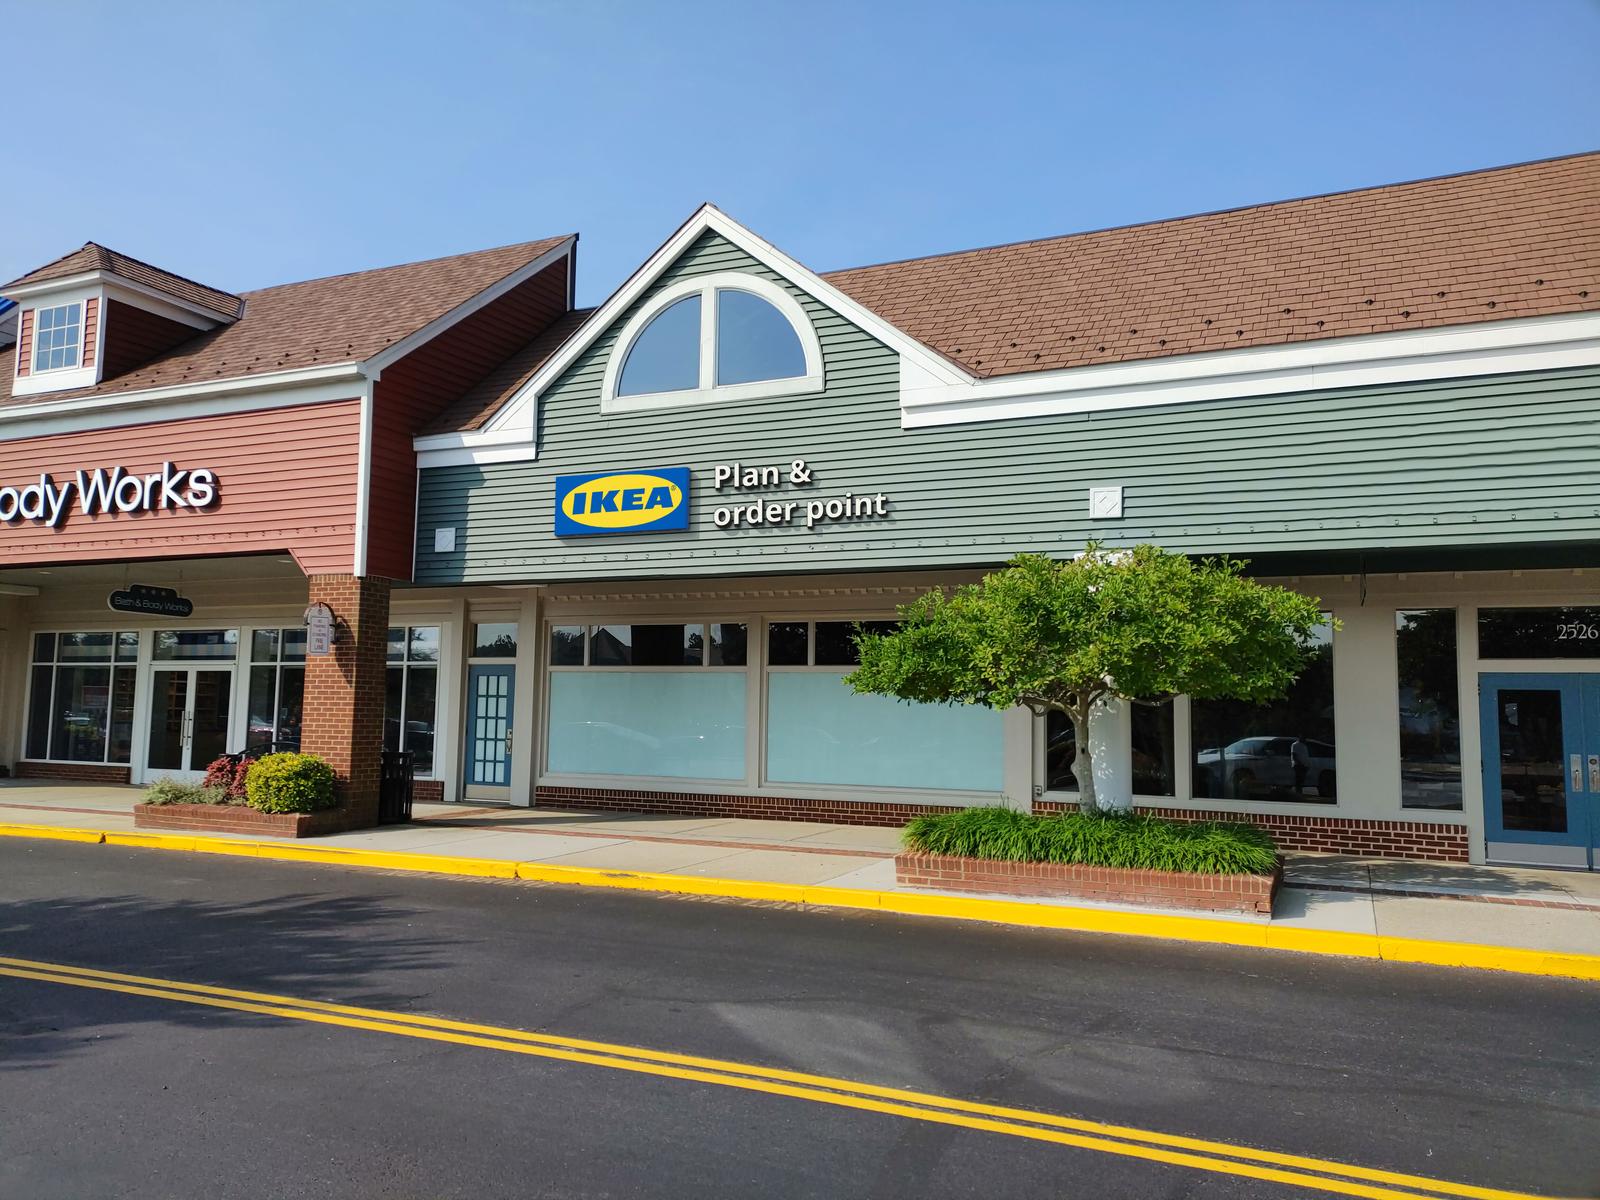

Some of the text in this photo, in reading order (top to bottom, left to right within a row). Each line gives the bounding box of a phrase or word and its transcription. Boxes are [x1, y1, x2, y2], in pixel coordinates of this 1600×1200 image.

[76, 462, 215, 514] Works
[714, 460, 811, 489] Plan &
[572, 486, 674, 515] IKEA
[713, 492, 887, 527] order point
[1556, 624, 1599, 639] 2526
